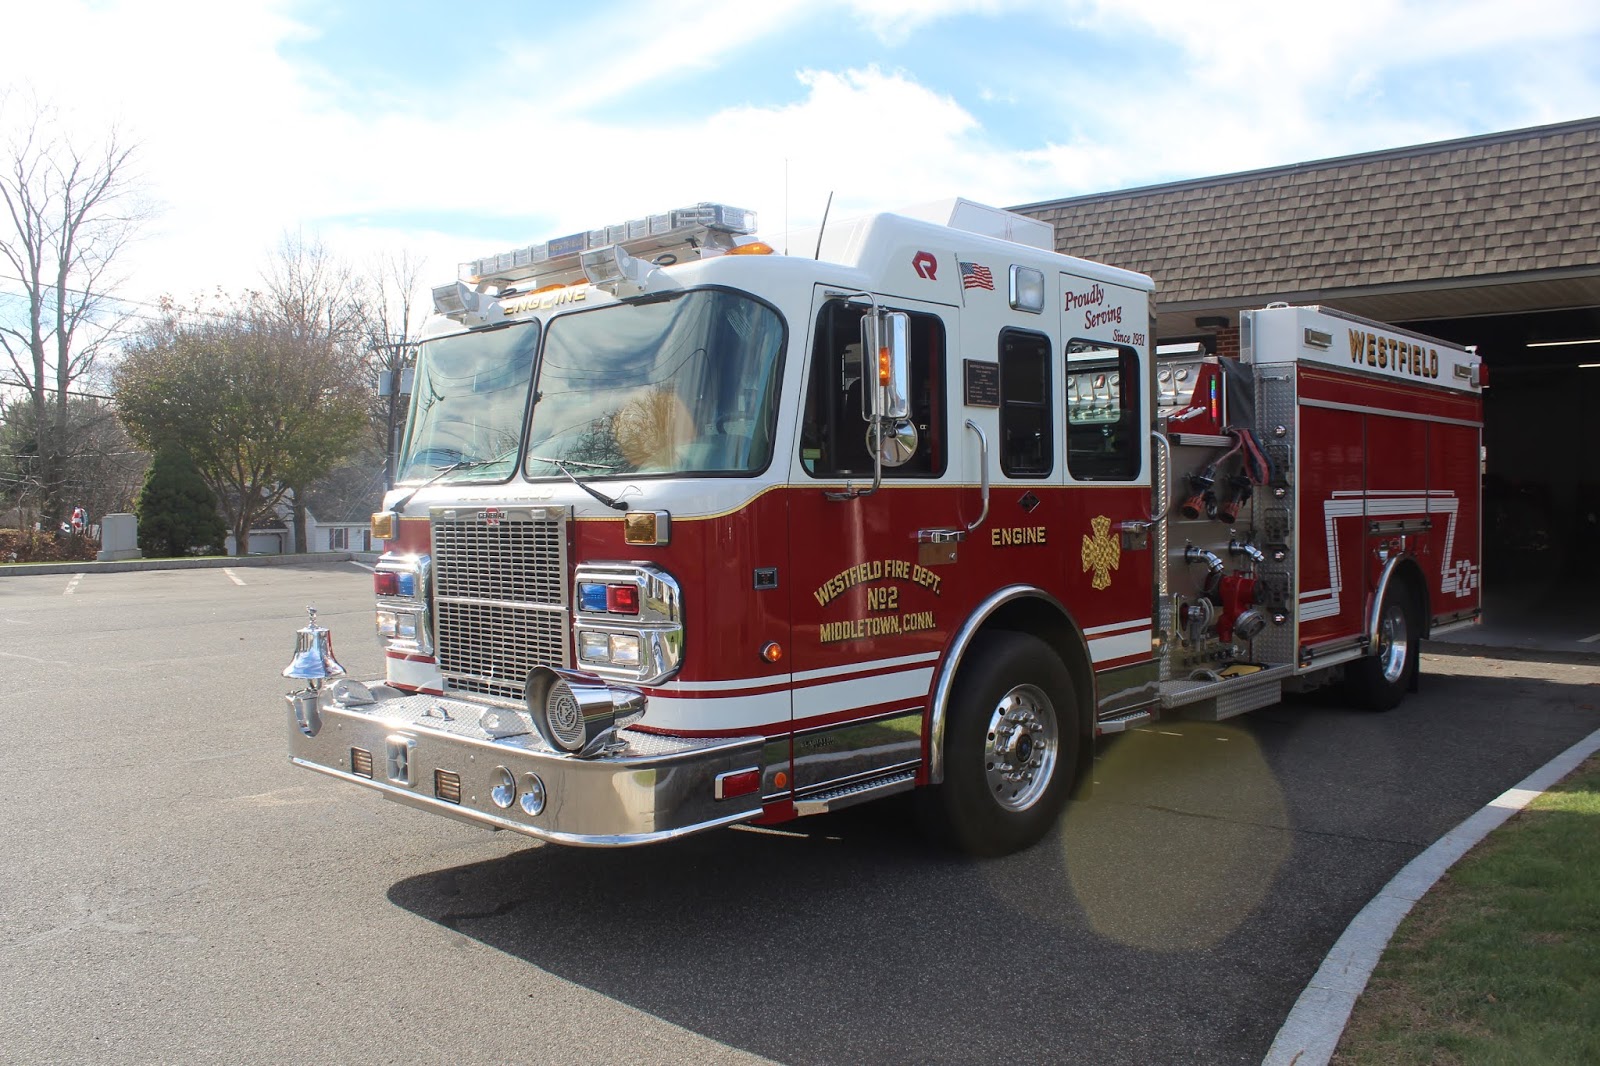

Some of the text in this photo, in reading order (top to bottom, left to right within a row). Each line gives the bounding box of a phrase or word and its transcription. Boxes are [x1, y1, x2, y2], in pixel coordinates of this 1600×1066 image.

[1065, 283, 1104, 311] Proudly
[1085, 304, 1122, 329] Serving
[1113, 329, 1145, 346] Since 1931
[1348, 328, 1439, 379] WESTFIELD
[991, 526, 1047, 546] ENGINE
[814, 560, 941, 607] WESTFIELD FIRE DEPT.
[820, 610, 937, 643] MIDDLETOWN, CONN.
